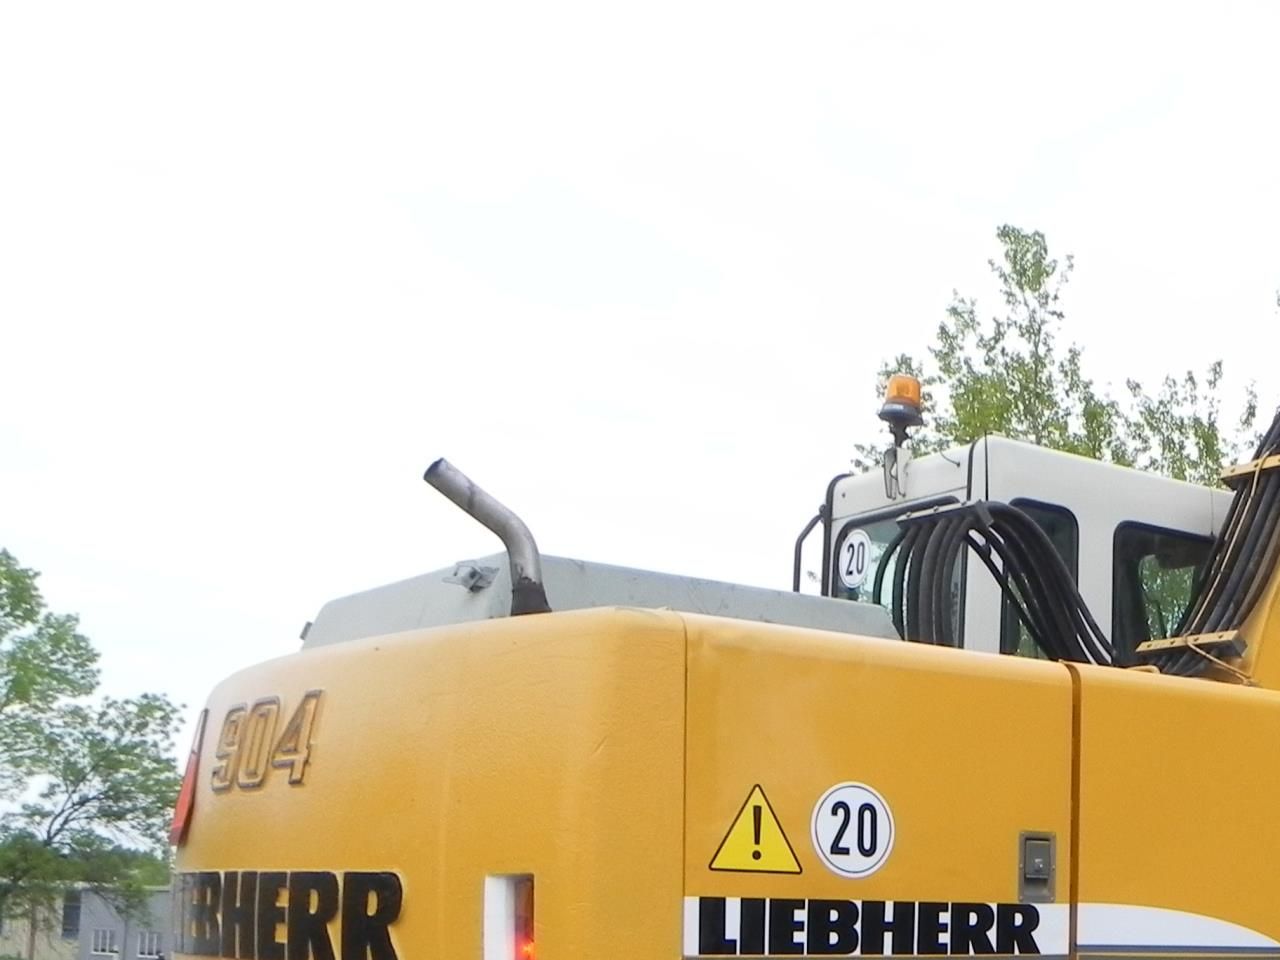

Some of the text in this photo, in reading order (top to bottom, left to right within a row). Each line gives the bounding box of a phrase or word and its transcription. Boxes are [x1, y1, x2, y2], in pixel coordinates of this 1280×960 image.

[846, 541, 865, 576] 20
[211, 689, 324, 793] 904
[830, 801, 878, 857] 20
[699, 896, 1041, 955] LIEBHERR
